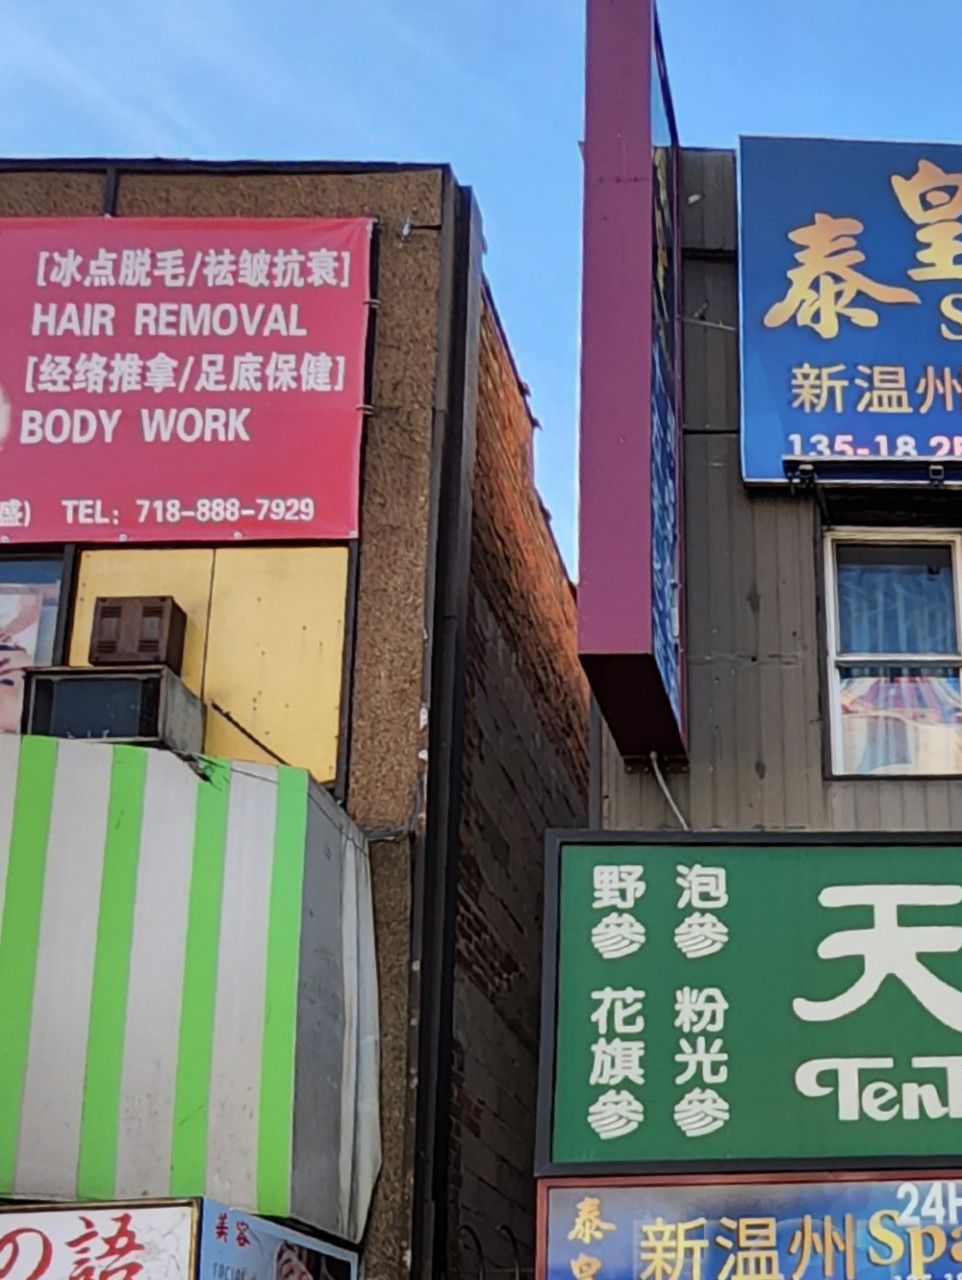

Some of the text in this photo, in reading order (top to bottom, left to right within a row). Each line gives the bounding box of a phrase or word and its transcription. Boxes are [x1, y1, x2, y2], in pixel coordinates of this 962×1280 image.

[36, 248, 351, 289] [冰点脱毛/祛皱抗衰]
[31, 303, 308, 336] HAIR REMOVAL
[25, 352, 346, 393] [经络推拿/足底保健]
[19, 407, 252, 444] BODY WORK
[61, 497, 315, 526] TEL: 718-888-7929
